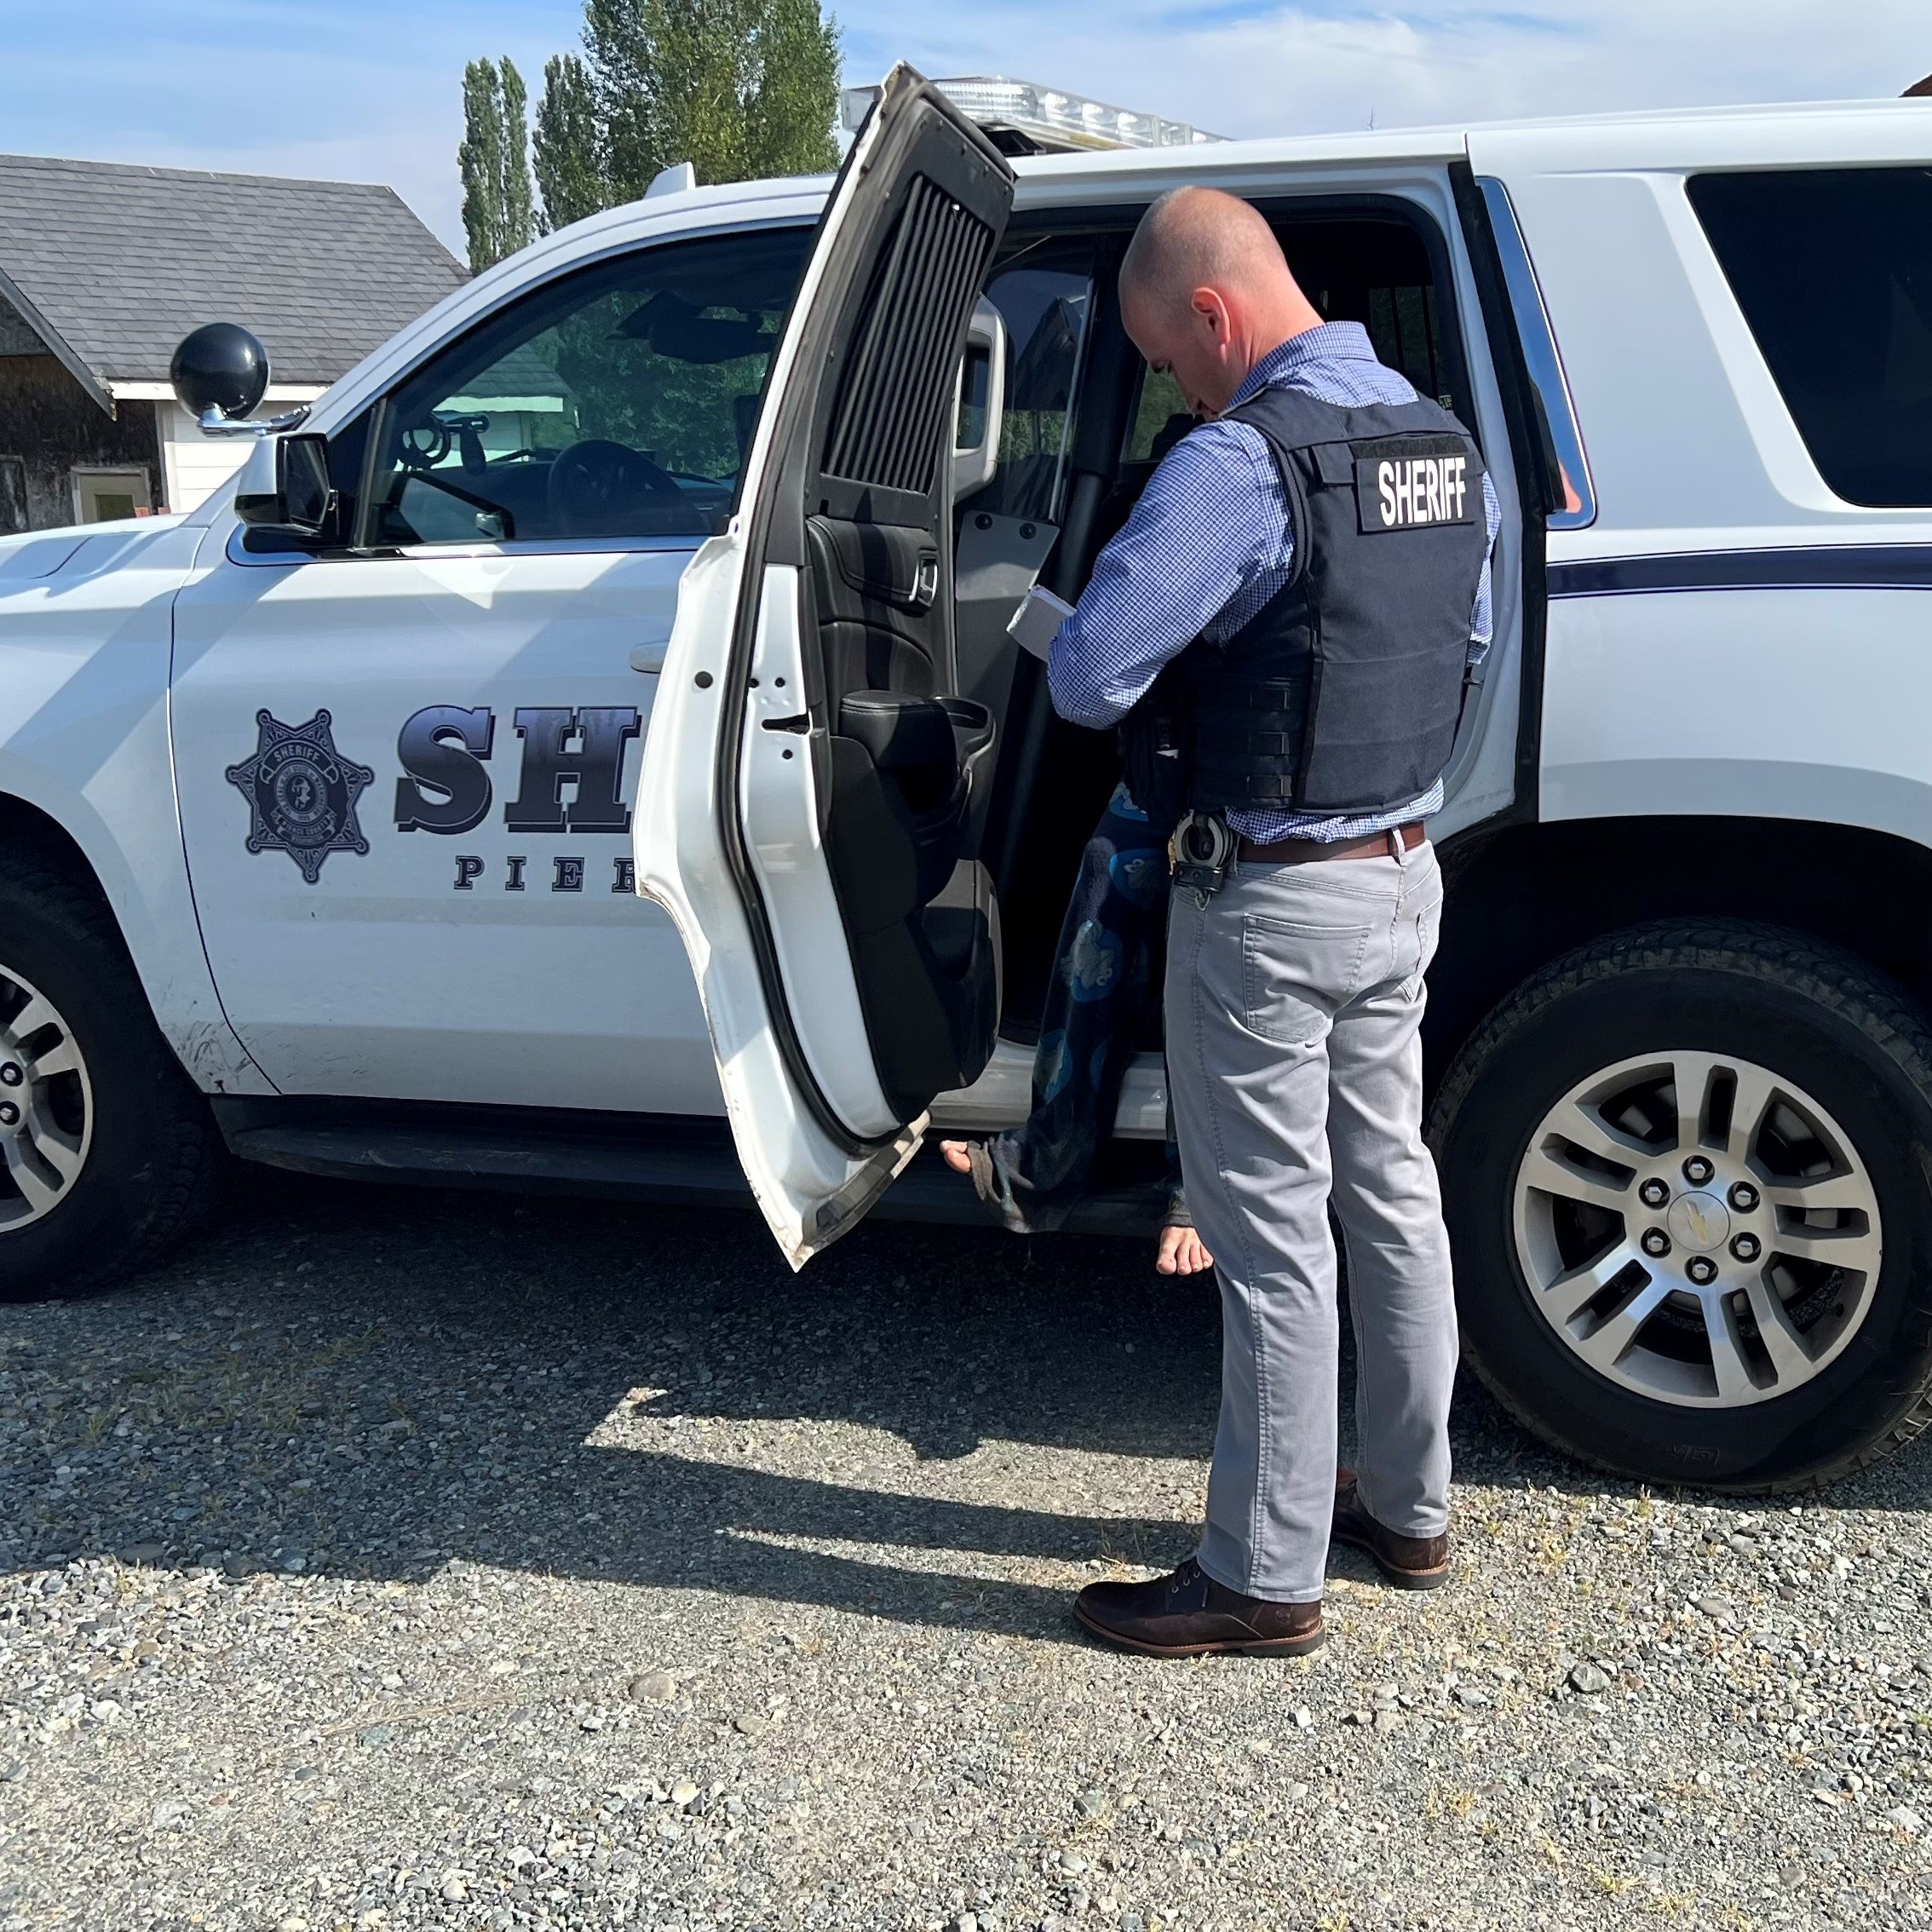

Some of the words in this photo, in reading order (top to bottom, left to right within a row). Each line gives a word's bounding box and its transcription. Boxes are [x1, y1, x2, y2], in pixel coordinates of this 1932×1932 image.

[1378, 457, 1466, 526] SHERIFF
[273, 745, 319, 762] SHERIFF
[394, 704, 641, 835] SH
